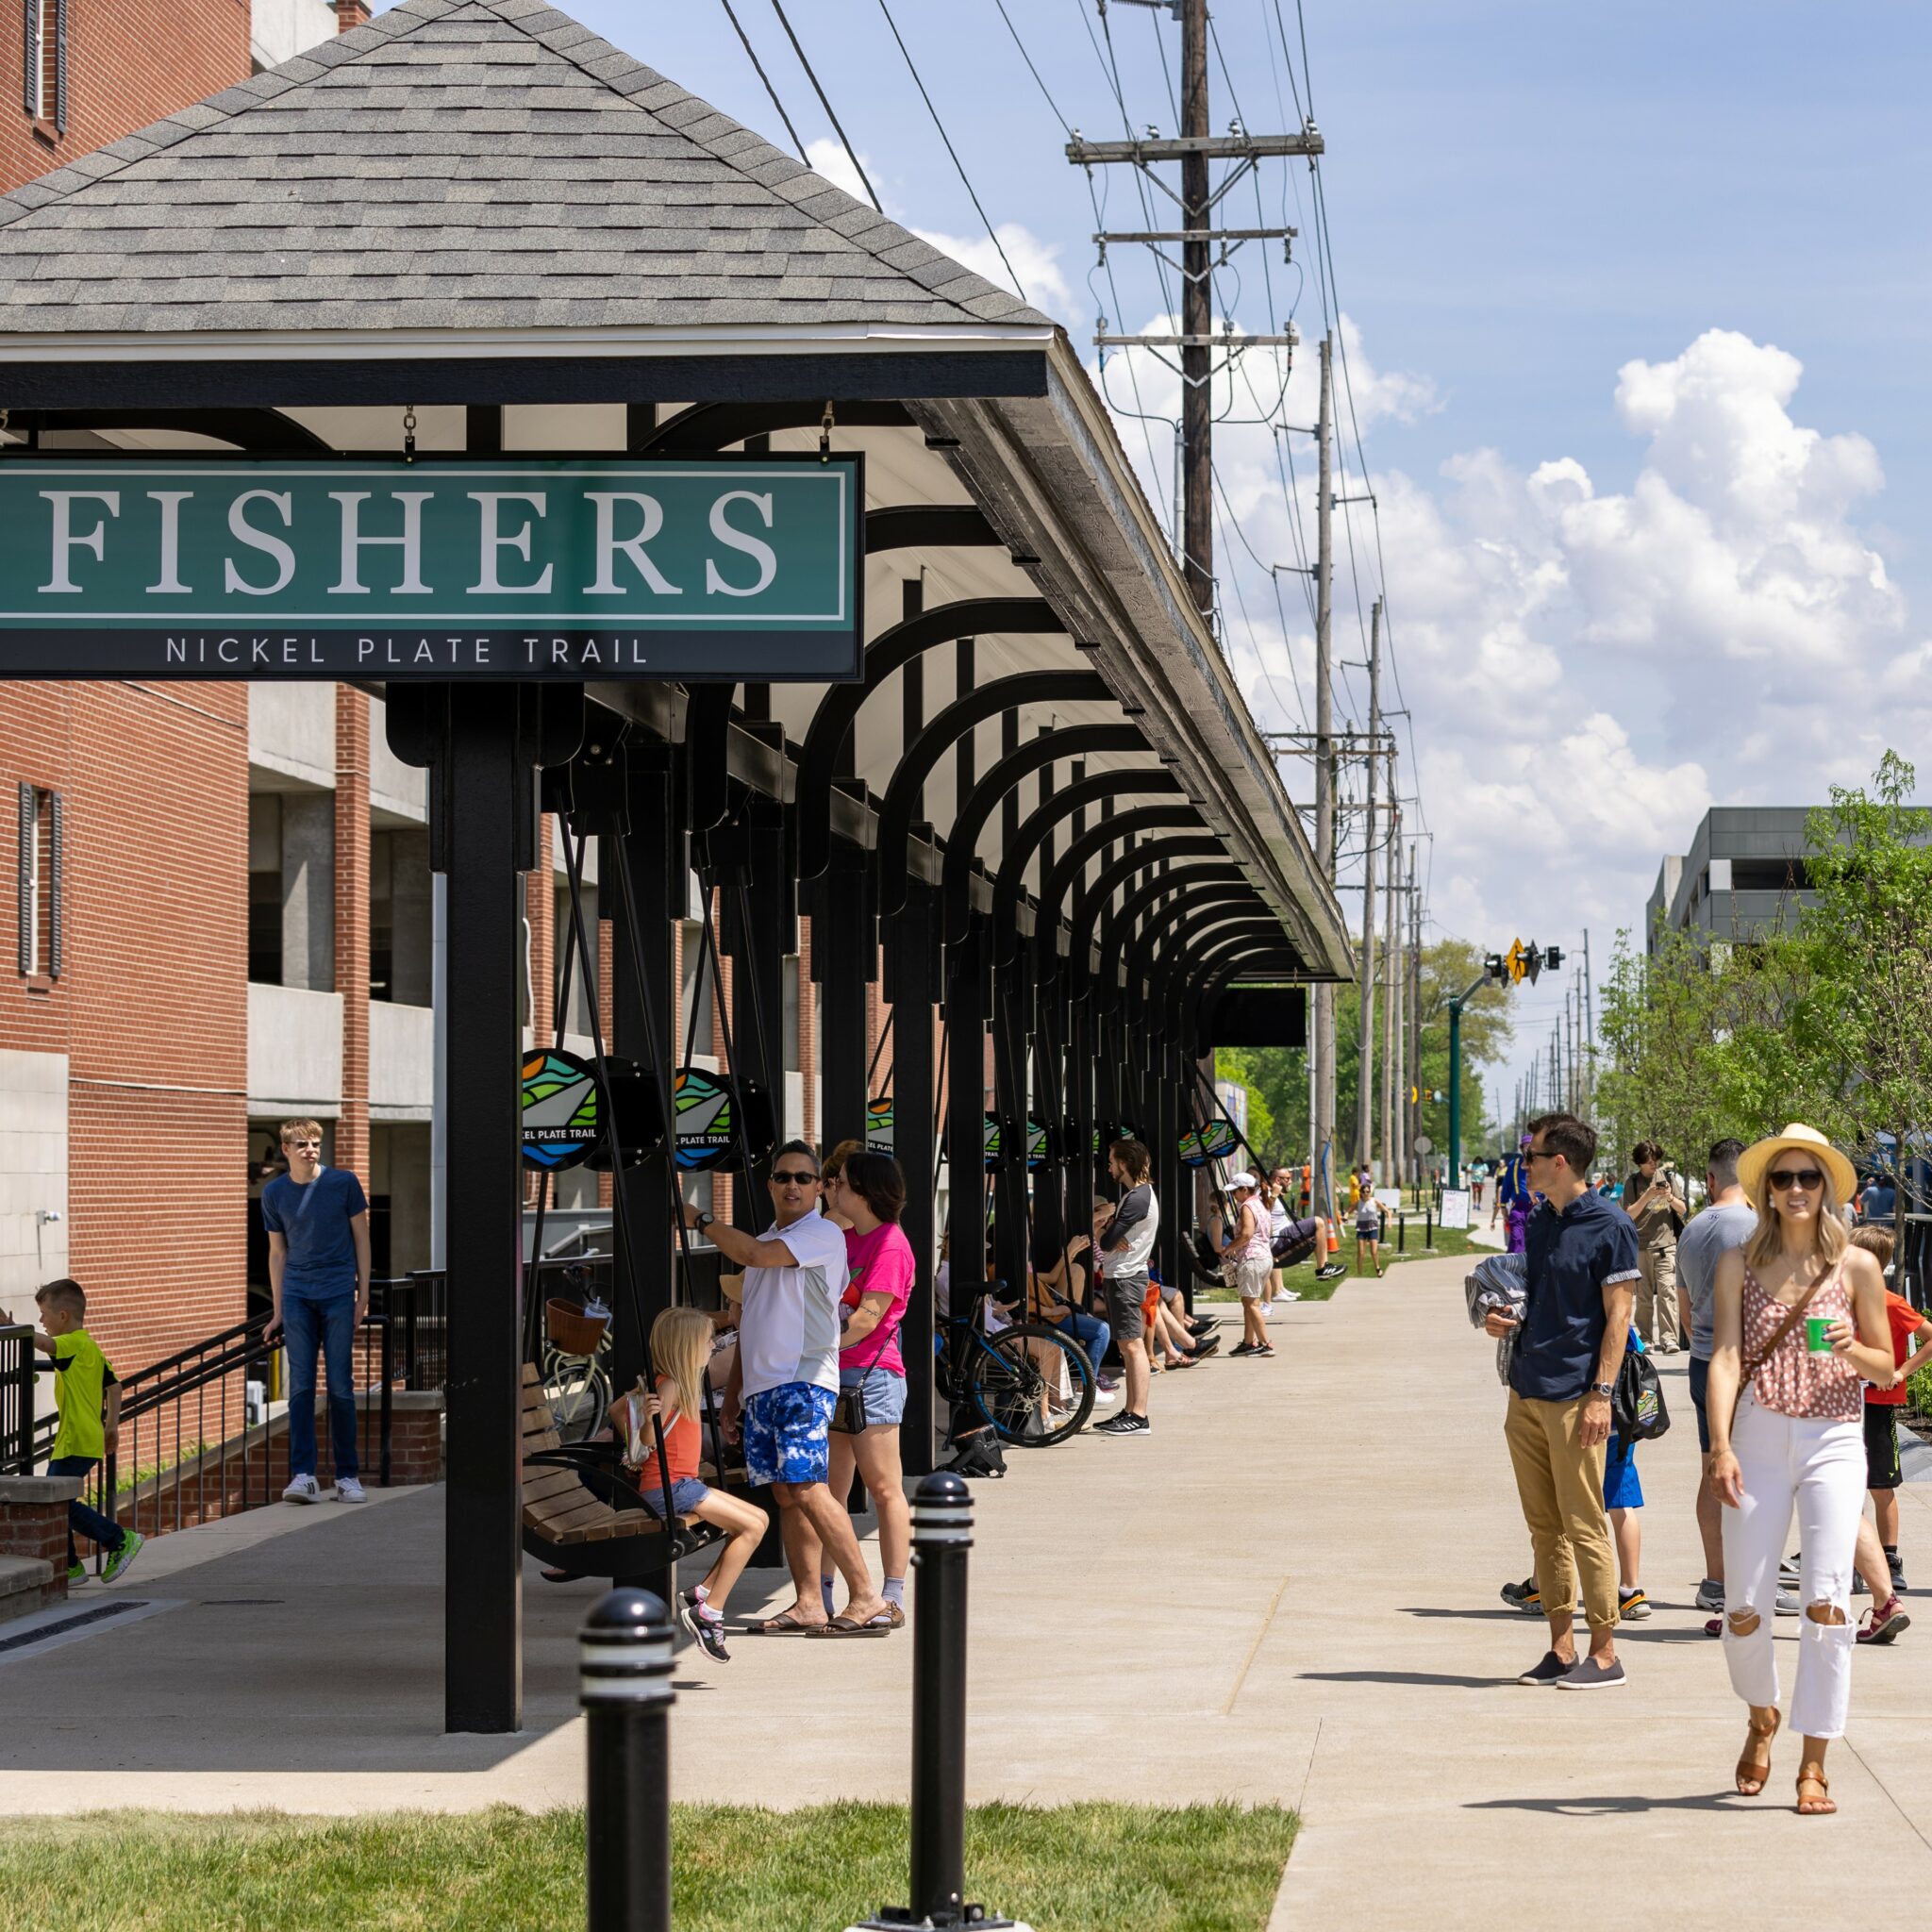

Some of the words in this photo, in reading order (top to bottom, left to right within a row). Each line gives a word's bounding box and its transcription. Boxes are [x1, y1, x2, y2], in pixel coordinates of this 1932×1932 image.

[36, 489, 778, 597] FISHERS
[165, 638, 325, 664] NICKEL
[358, 638, 491, 664] PLATE
[524, 638, 647, 664] TRAIL
[538, 1129, 567, 1140] PLATE
[569, 1128, 596, 1138] TRAIL
[680, 1136, 705, 1145] PLATE
[707, 1135, 730, 1143] TRAIL
